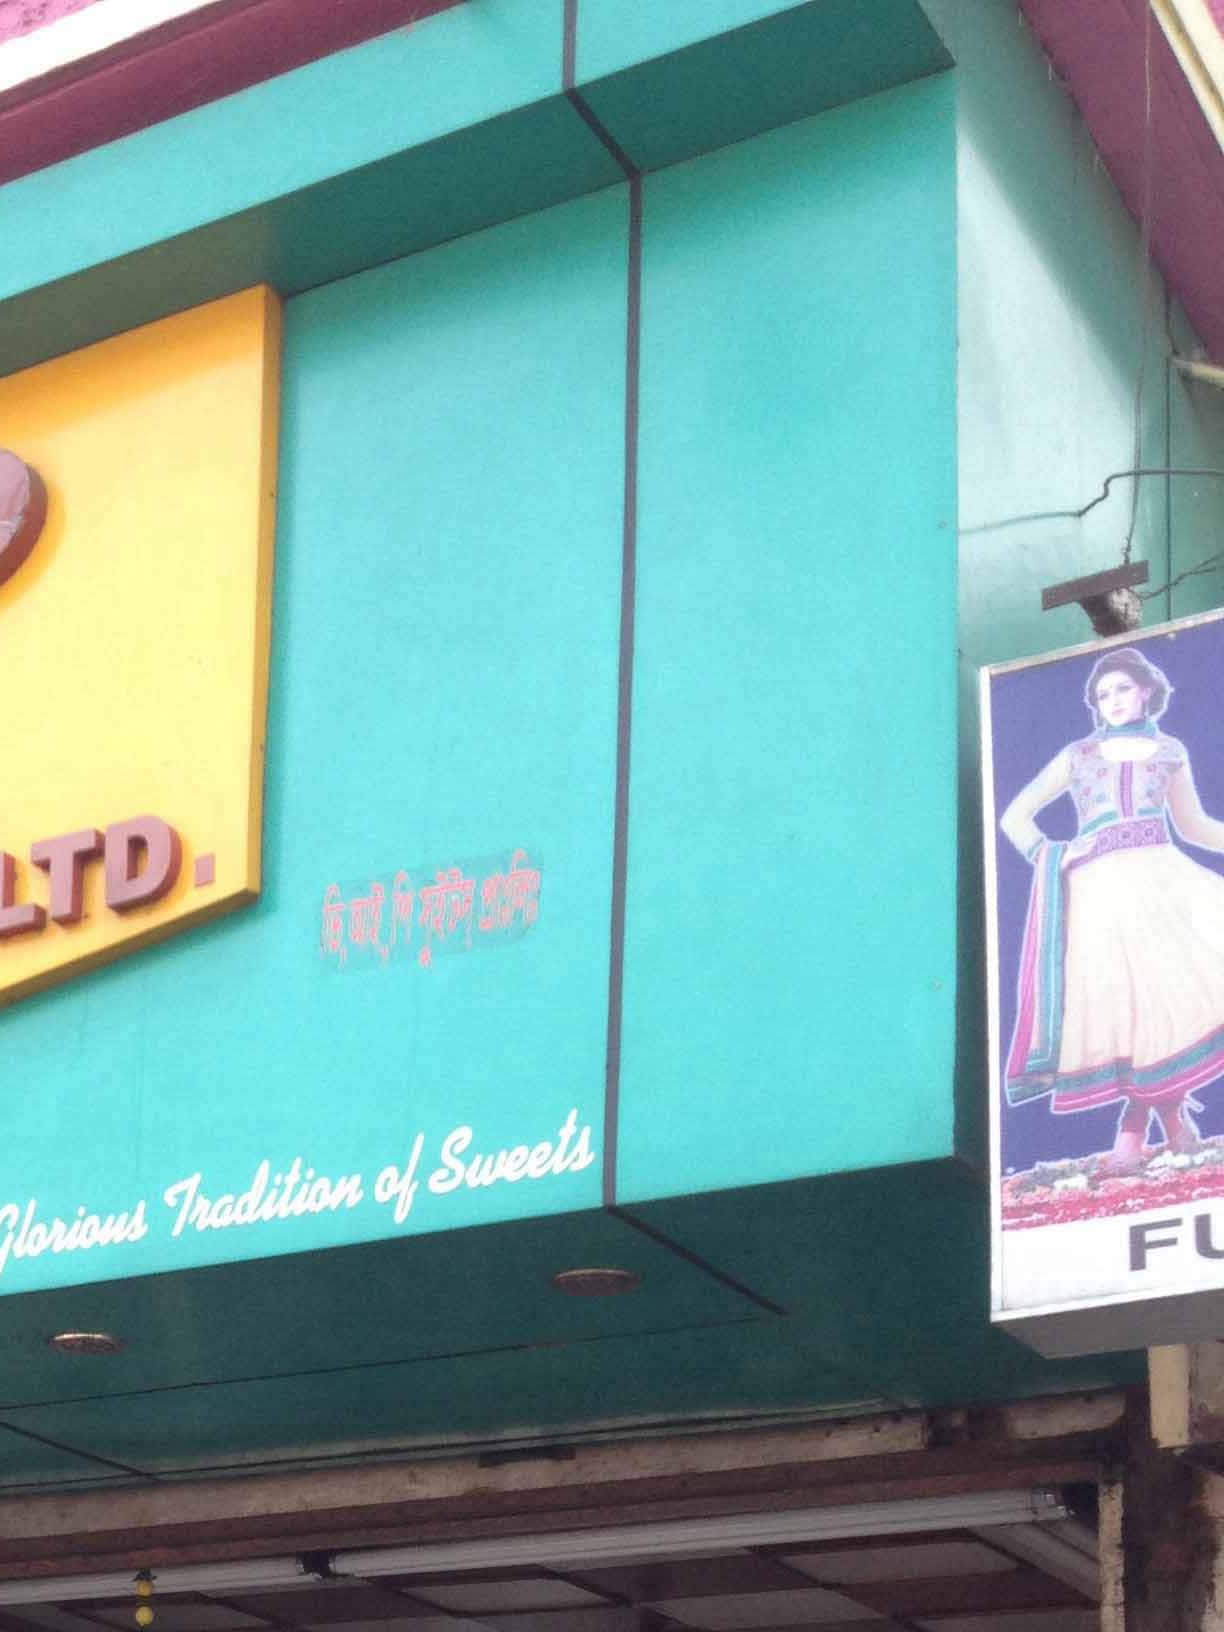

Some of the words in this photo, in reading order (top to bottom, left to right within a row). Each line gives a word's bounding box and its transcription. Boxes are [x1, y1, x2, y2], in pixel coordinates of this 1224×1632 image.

[163, 1157, 364, 1238] Tradition
[374, 1131, 425, 1224] of
[428, 1107, 596, 1194] Sweets
